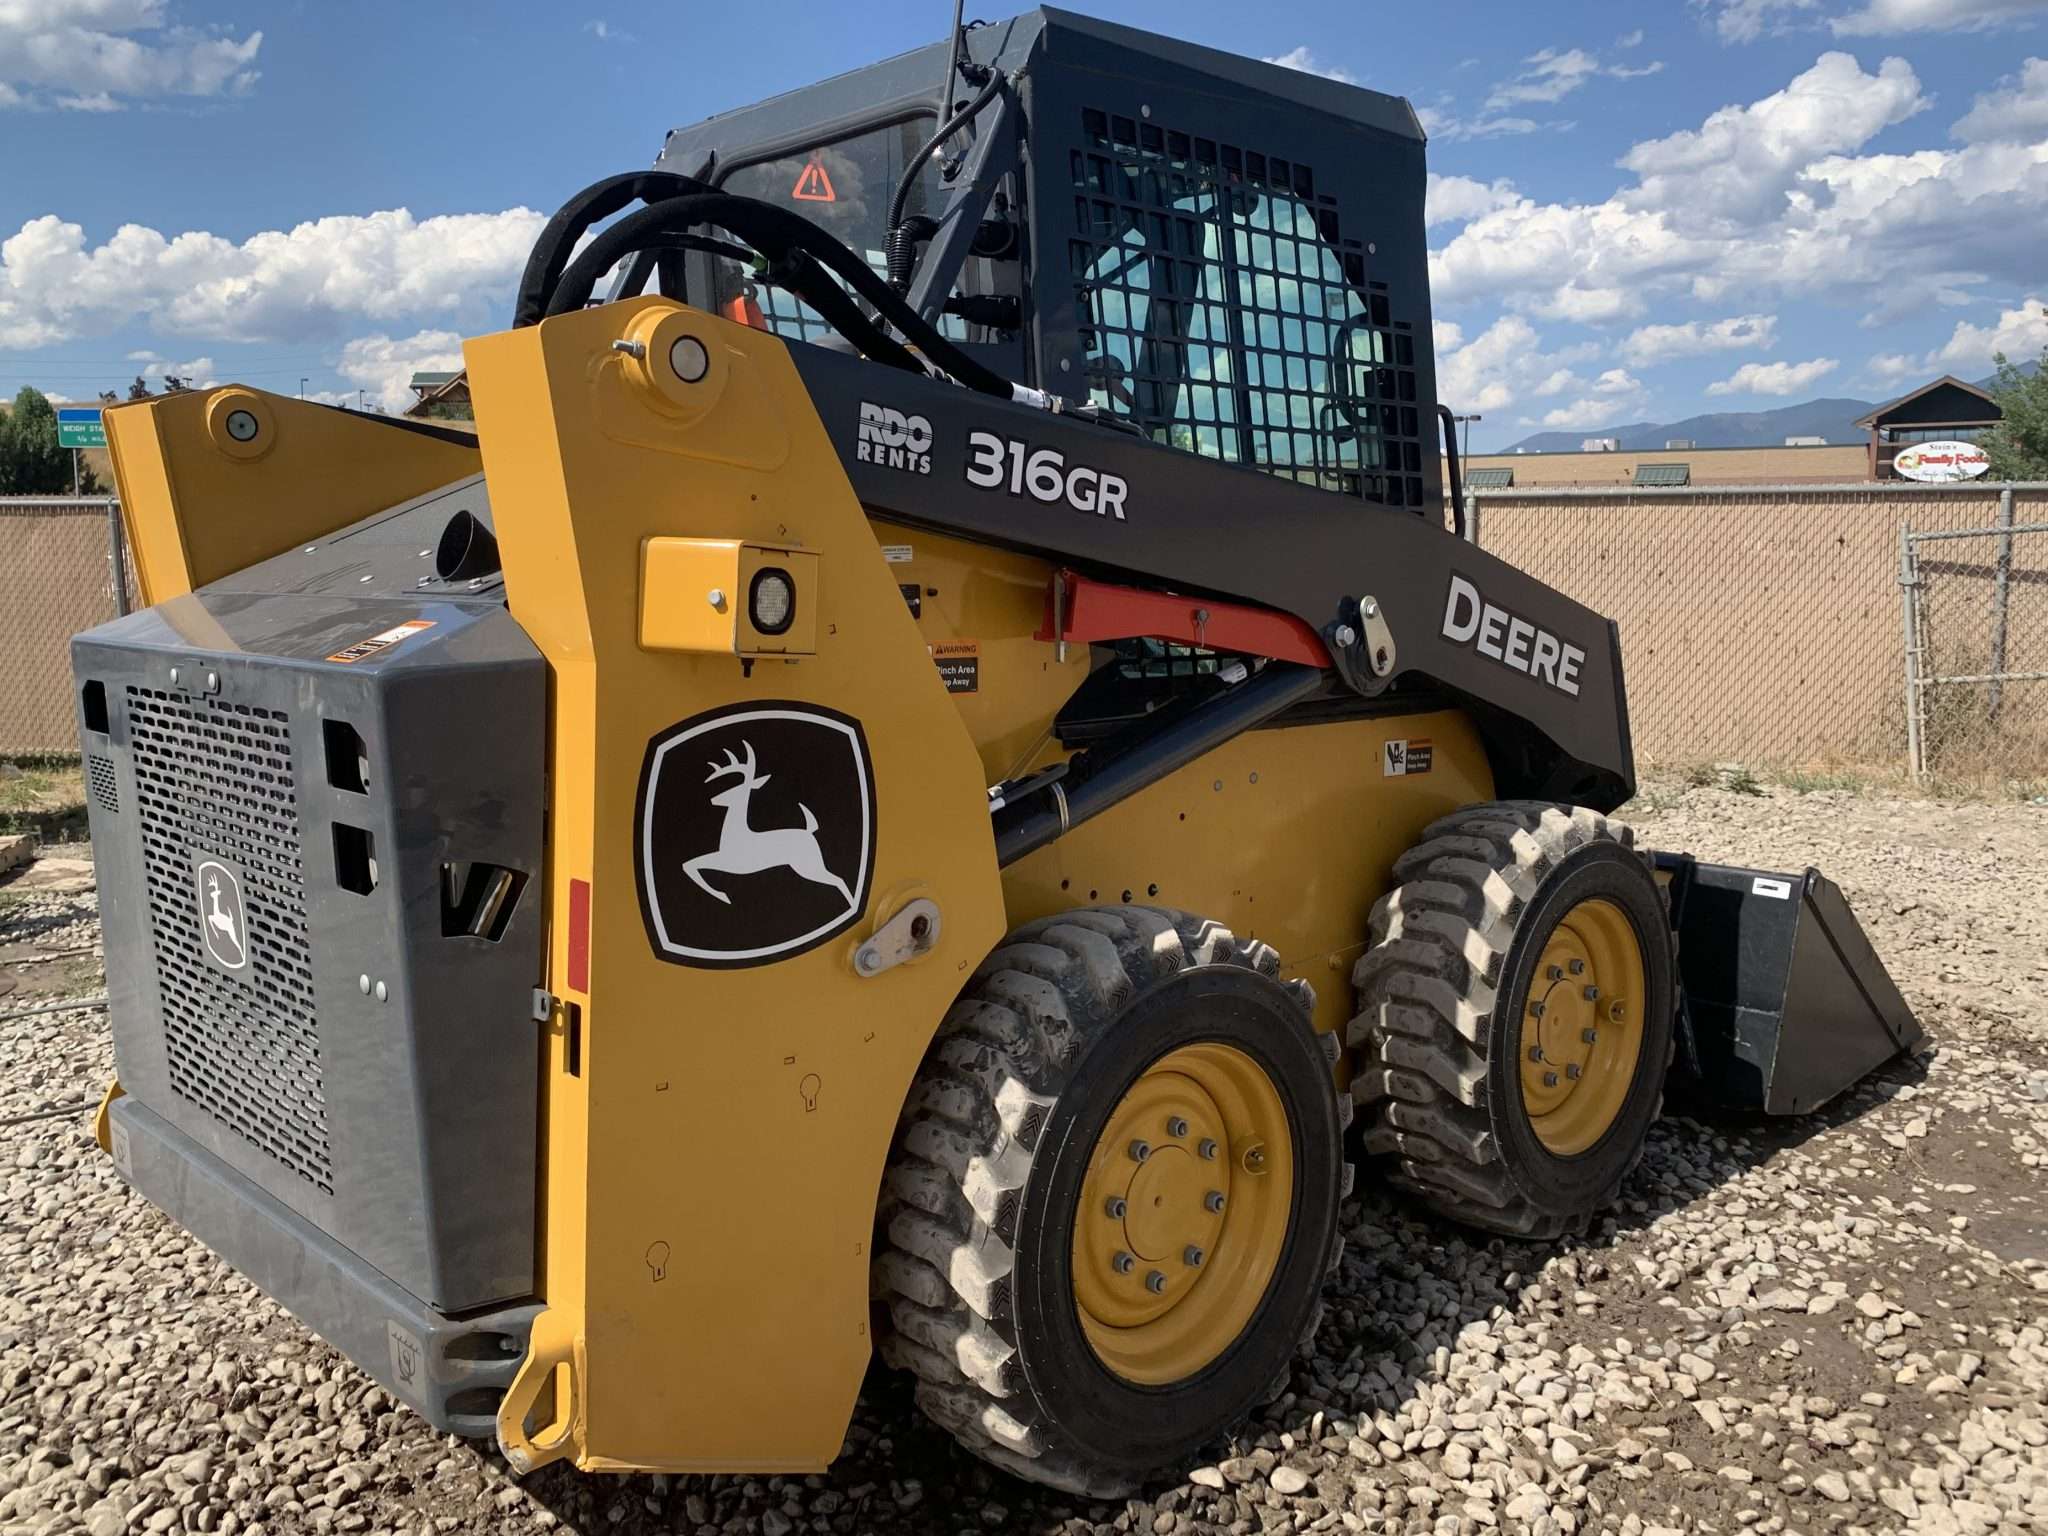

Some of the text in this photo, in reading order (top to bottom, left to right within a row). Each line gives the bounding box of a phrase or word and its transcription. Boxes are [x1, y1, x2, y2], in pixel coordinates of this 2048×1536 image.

[859, 401, 934, 453] RDO
[857, 440, 931, 475] RENTS
[1918, 454, 1953, 467] Family
[966, 432, 1128, 520] 316GR
[943, 644, 977, 654] WARNING
[957, 665, 976, 674] Area
[952, 678, 970, 687] Away
